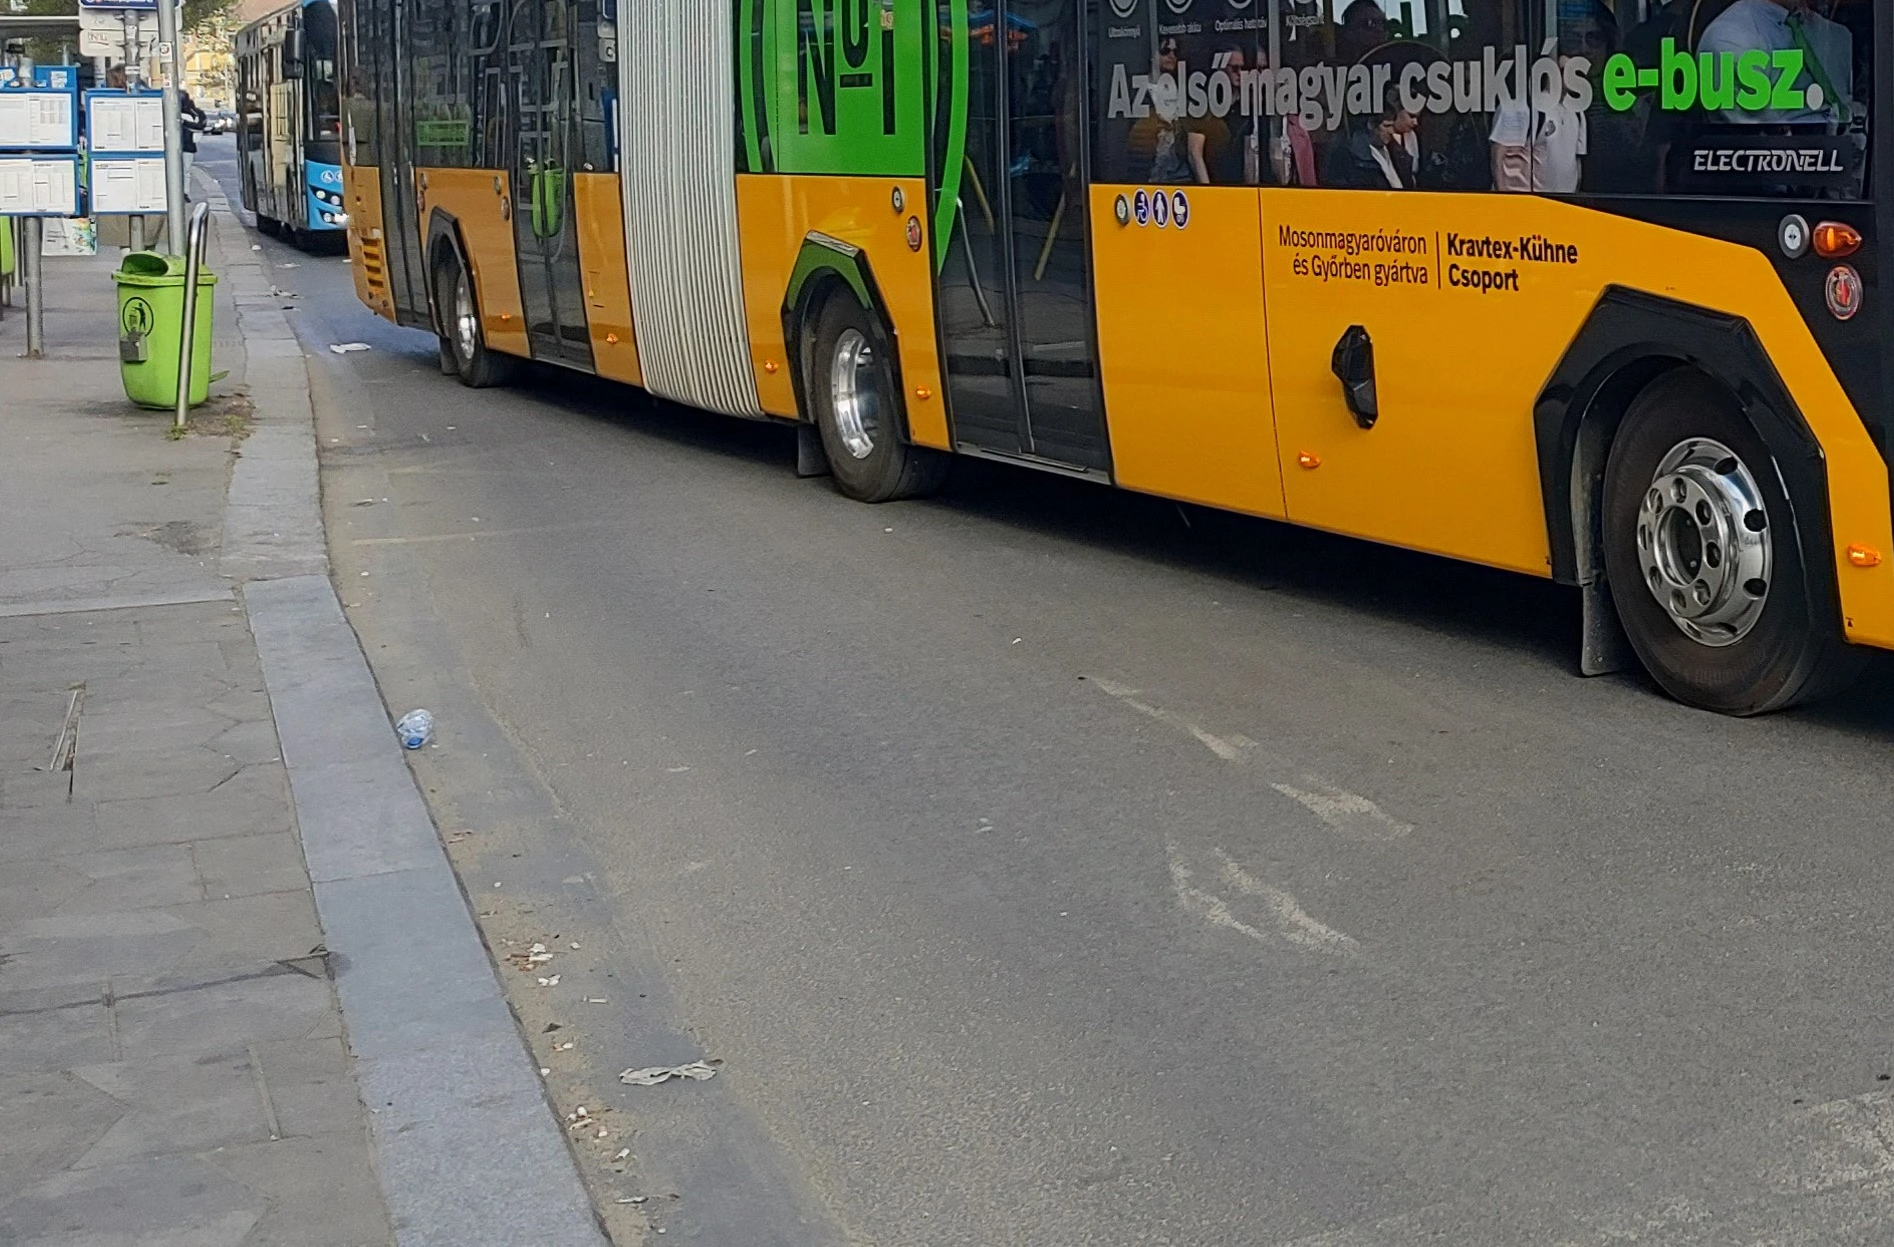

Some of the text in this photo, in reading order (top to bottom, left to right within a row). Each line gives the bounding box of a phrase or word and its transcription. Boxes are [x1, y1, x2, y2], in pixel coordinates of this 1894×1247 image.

[1107, 37, 1824, 132] Az első magyar csuklós e-busz.
[1693, 149, 1844, 172] ELECTRONELL
[1279, 224, 1427, 256] Mosonmagyaróváron
[1447, 233, 1578, 264] Kravtex-Kühne
[1293, 253, 1428, 286] és Győrben gyártva
[1449, 264, 1519, 294] Csoport
